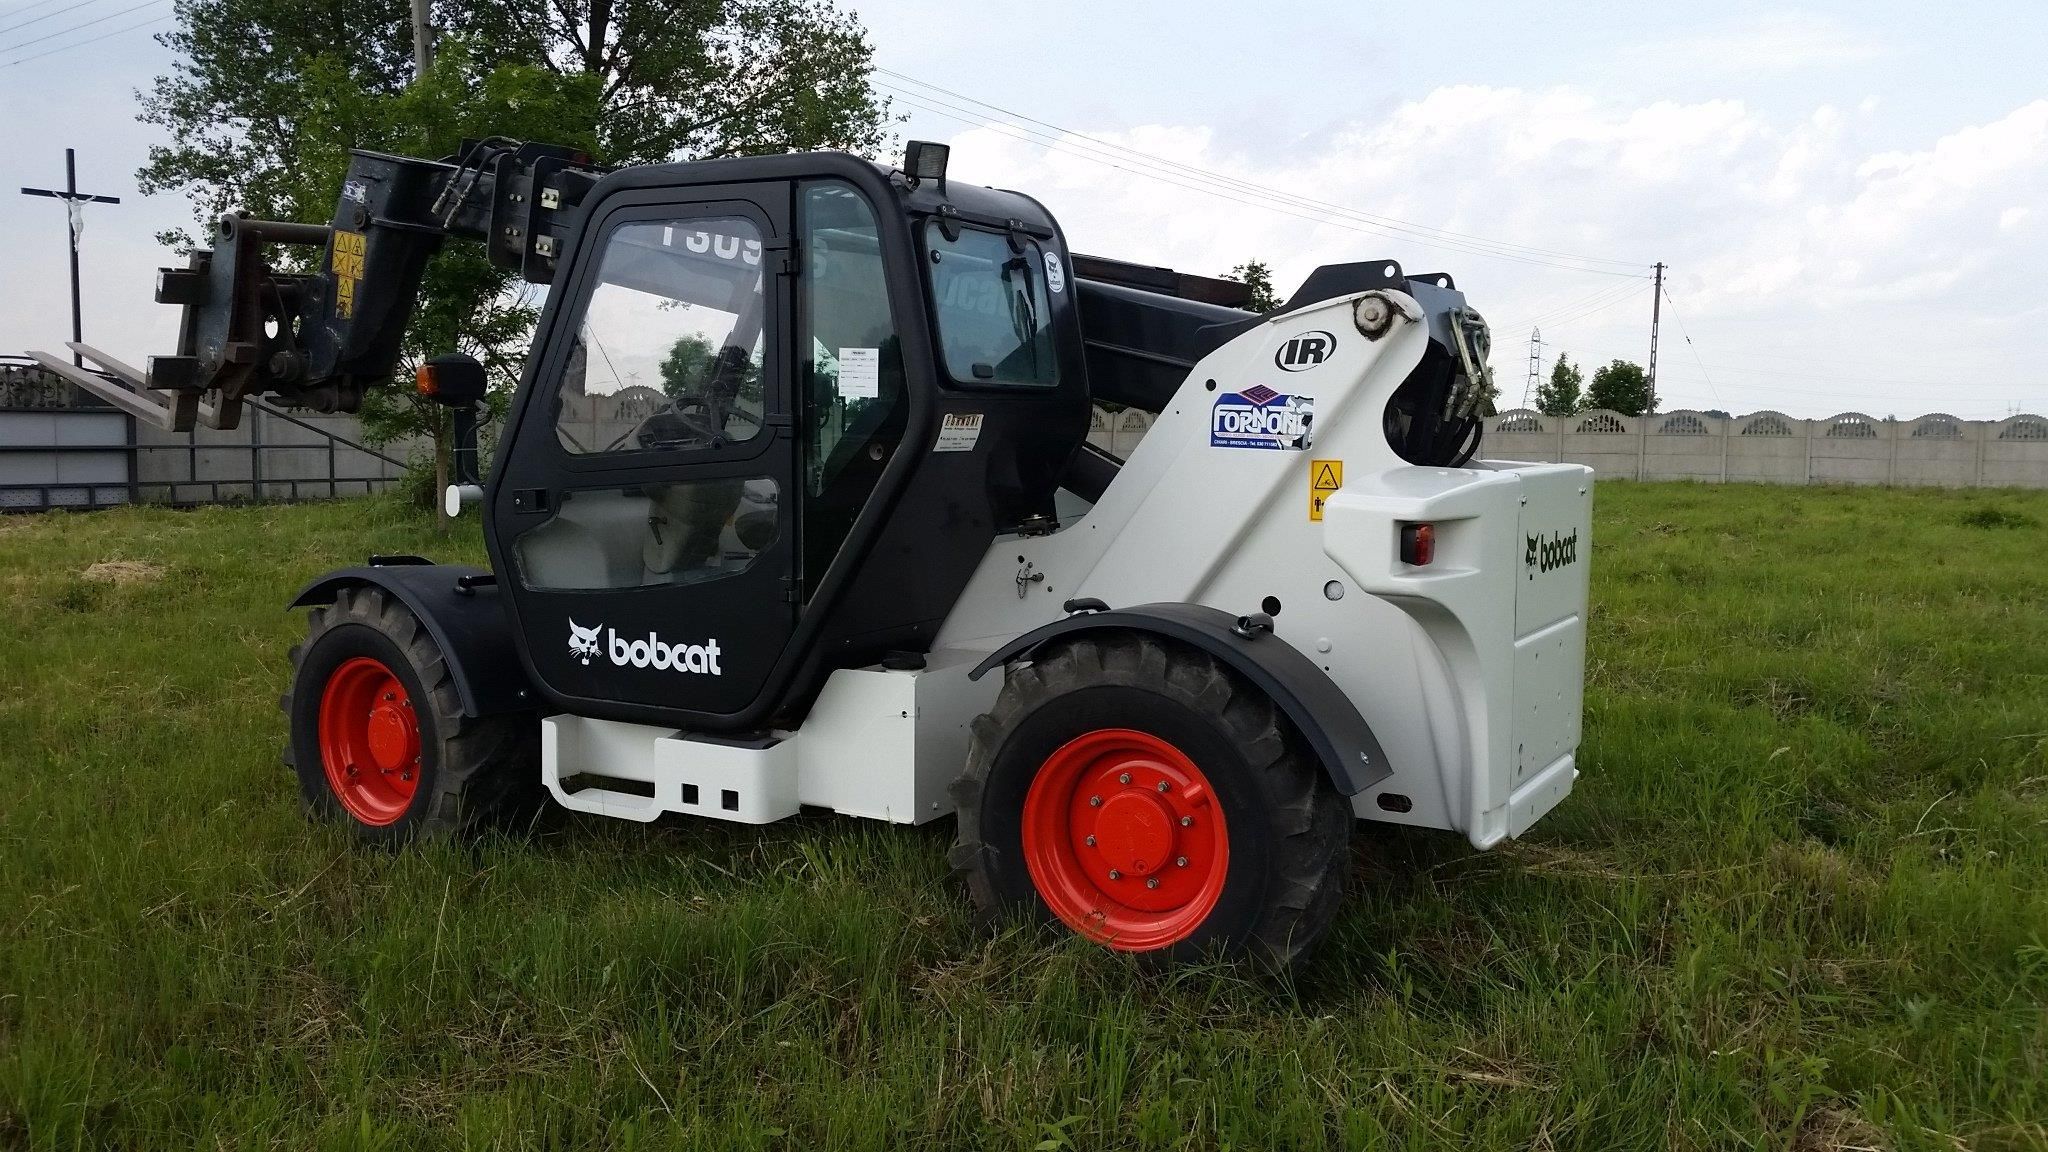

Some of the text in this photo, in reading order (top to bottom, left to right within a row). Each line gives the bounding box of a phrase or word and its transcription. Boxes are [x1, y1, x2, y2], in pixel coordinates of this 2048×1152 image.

[1284, 338, 1327, 365] IR
[1540, 527, 1577, 574] bobcat
[608, 627, 722, 676] bobcat
